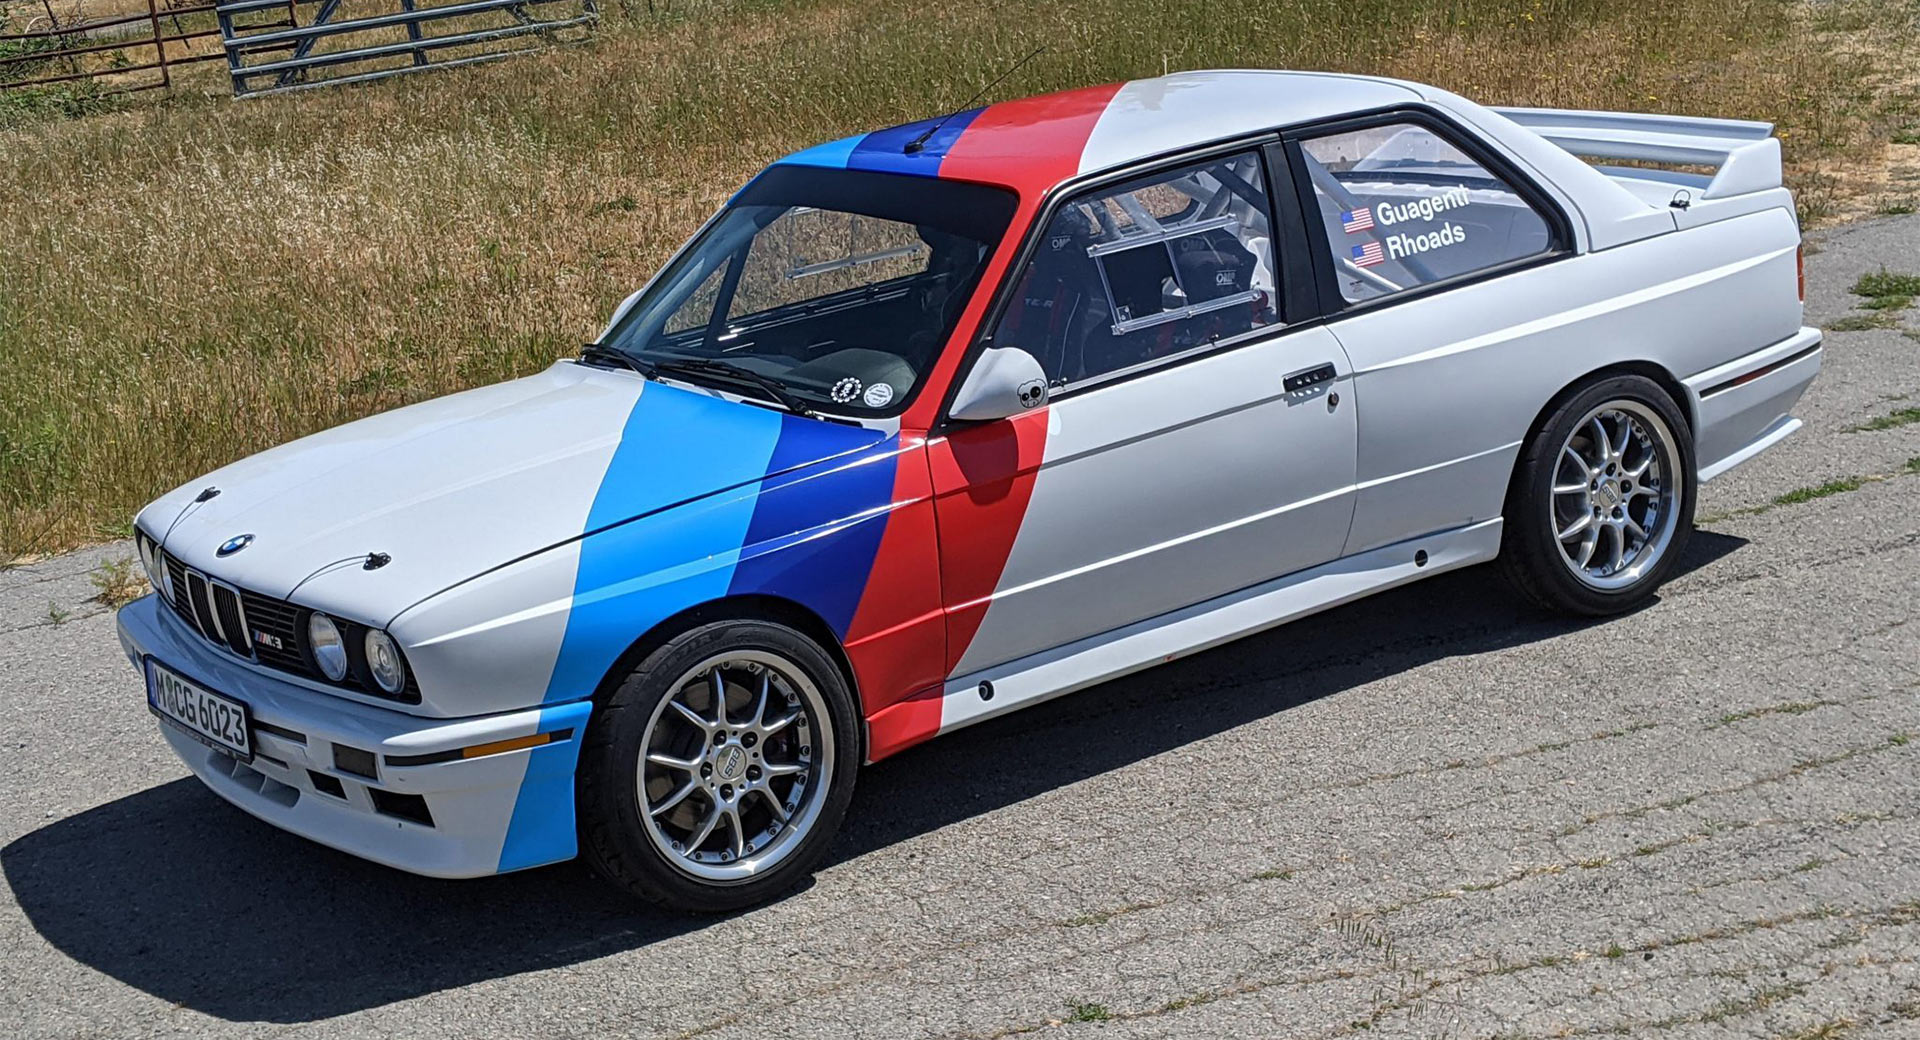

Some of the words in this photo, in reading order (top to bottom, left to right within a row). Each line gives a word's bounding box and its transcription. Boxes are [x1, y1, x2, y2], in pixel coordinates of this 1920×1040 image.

[1377, 184, 1471, 225] Guagenti
[1386, 222, 1466, 260] Rhoads
[199, 694, 245, 747] 6023
[724, 748, 740, 777] BBS
